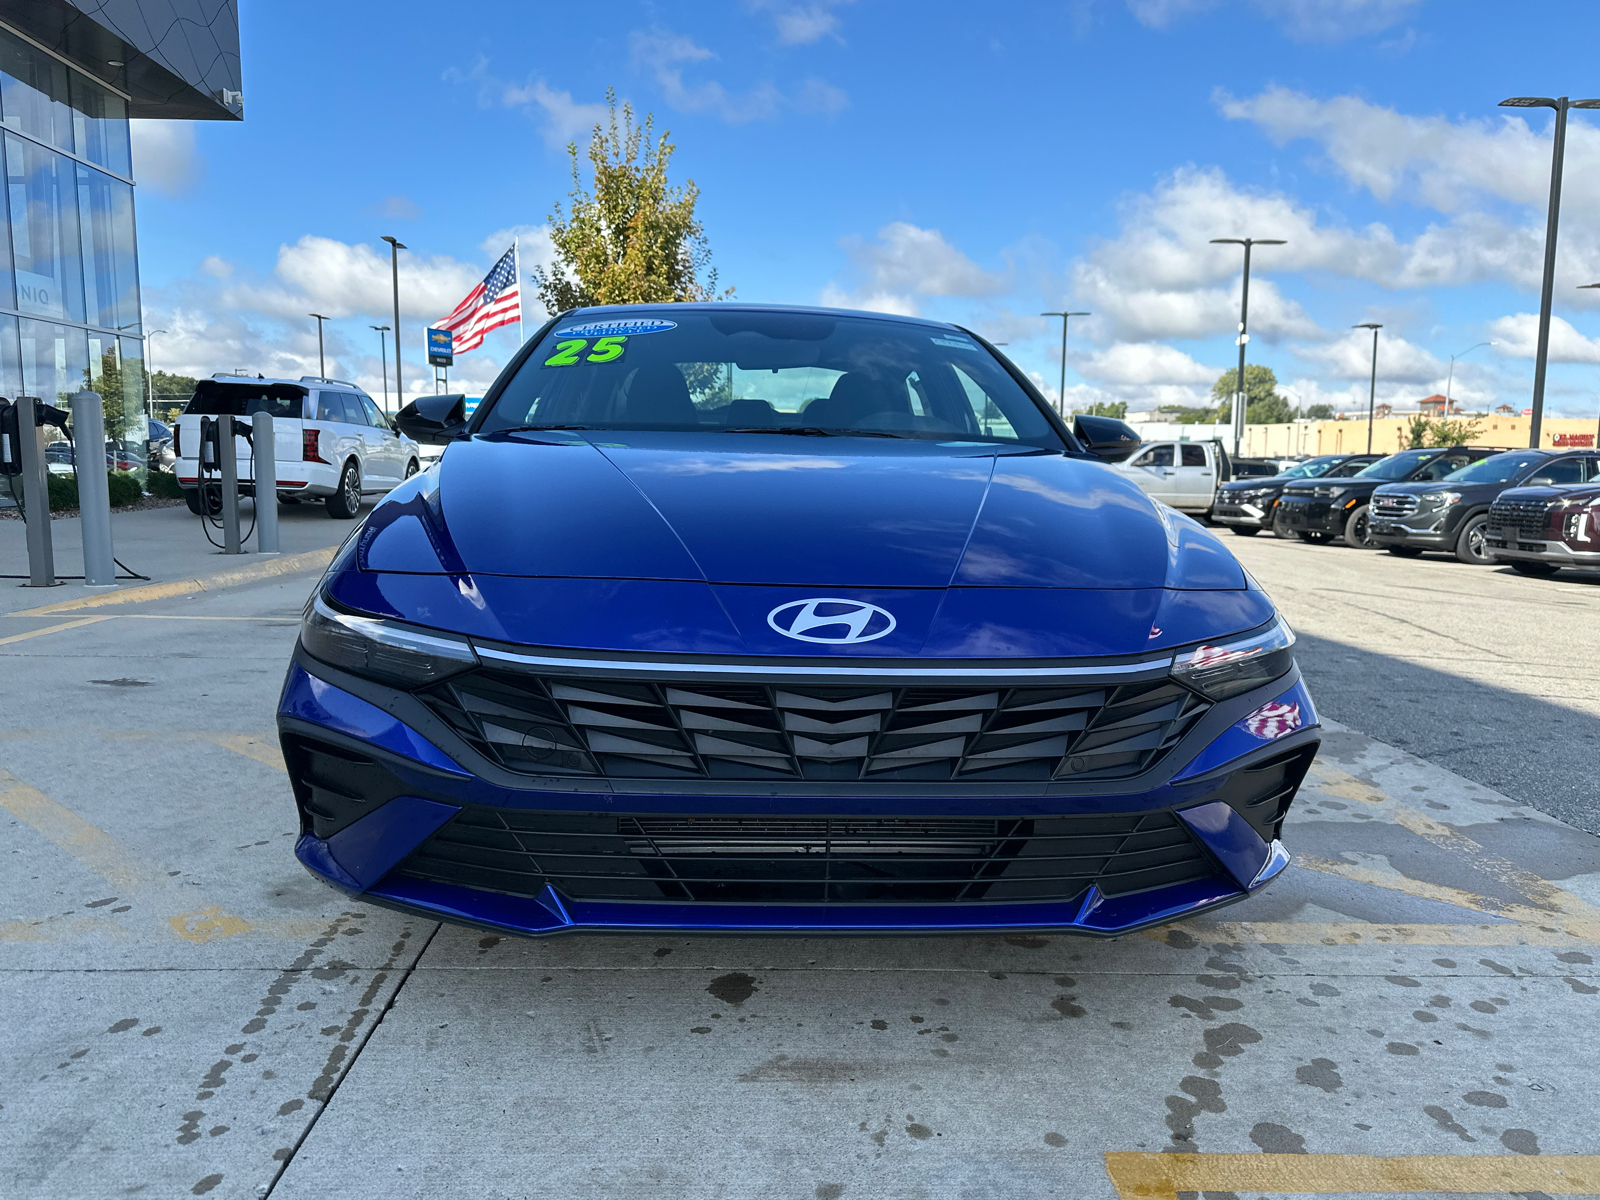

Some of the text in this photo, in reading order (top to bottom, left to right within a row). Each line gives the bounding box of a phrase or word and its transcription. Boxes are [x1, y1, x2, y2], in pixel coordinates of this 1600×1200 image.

[17, 284, 49, 306] NIQ
[570, 320, 664, 332] CERTIFIED
[545, 336, 628, 366] 25
